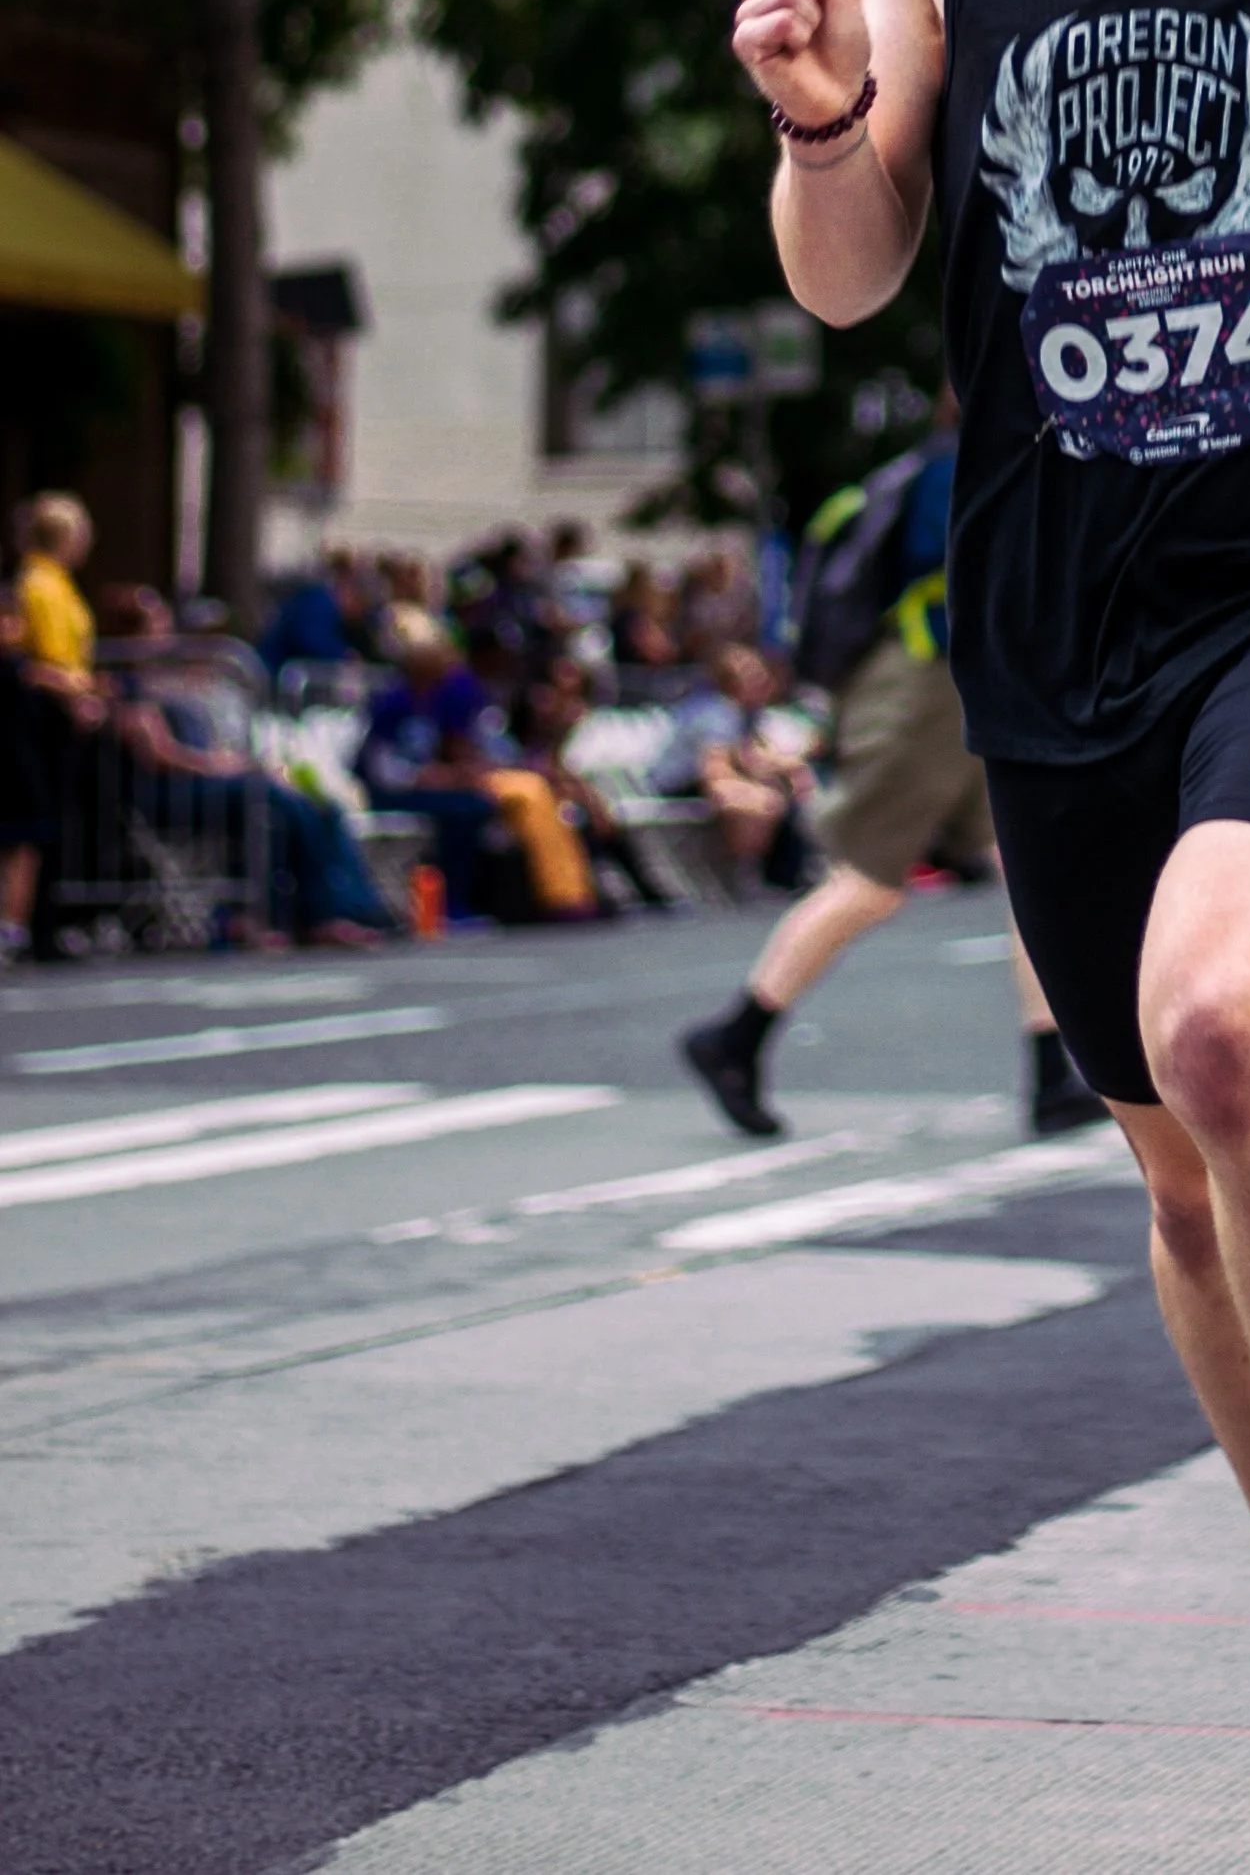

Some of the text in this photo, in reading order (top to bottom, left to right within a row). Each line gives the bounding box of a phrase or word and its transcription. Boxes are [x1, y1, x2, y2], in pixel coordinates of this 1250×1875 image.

[1066, 7, 1237, 79] OREGON
[1058, 63, 1241, 168] PROJECT
[1113, 146, 1176, 187] 1972
[1061, 261, 1196, 302] TORCHLIGHT
[1200, 252, 1246, 278] RUN
